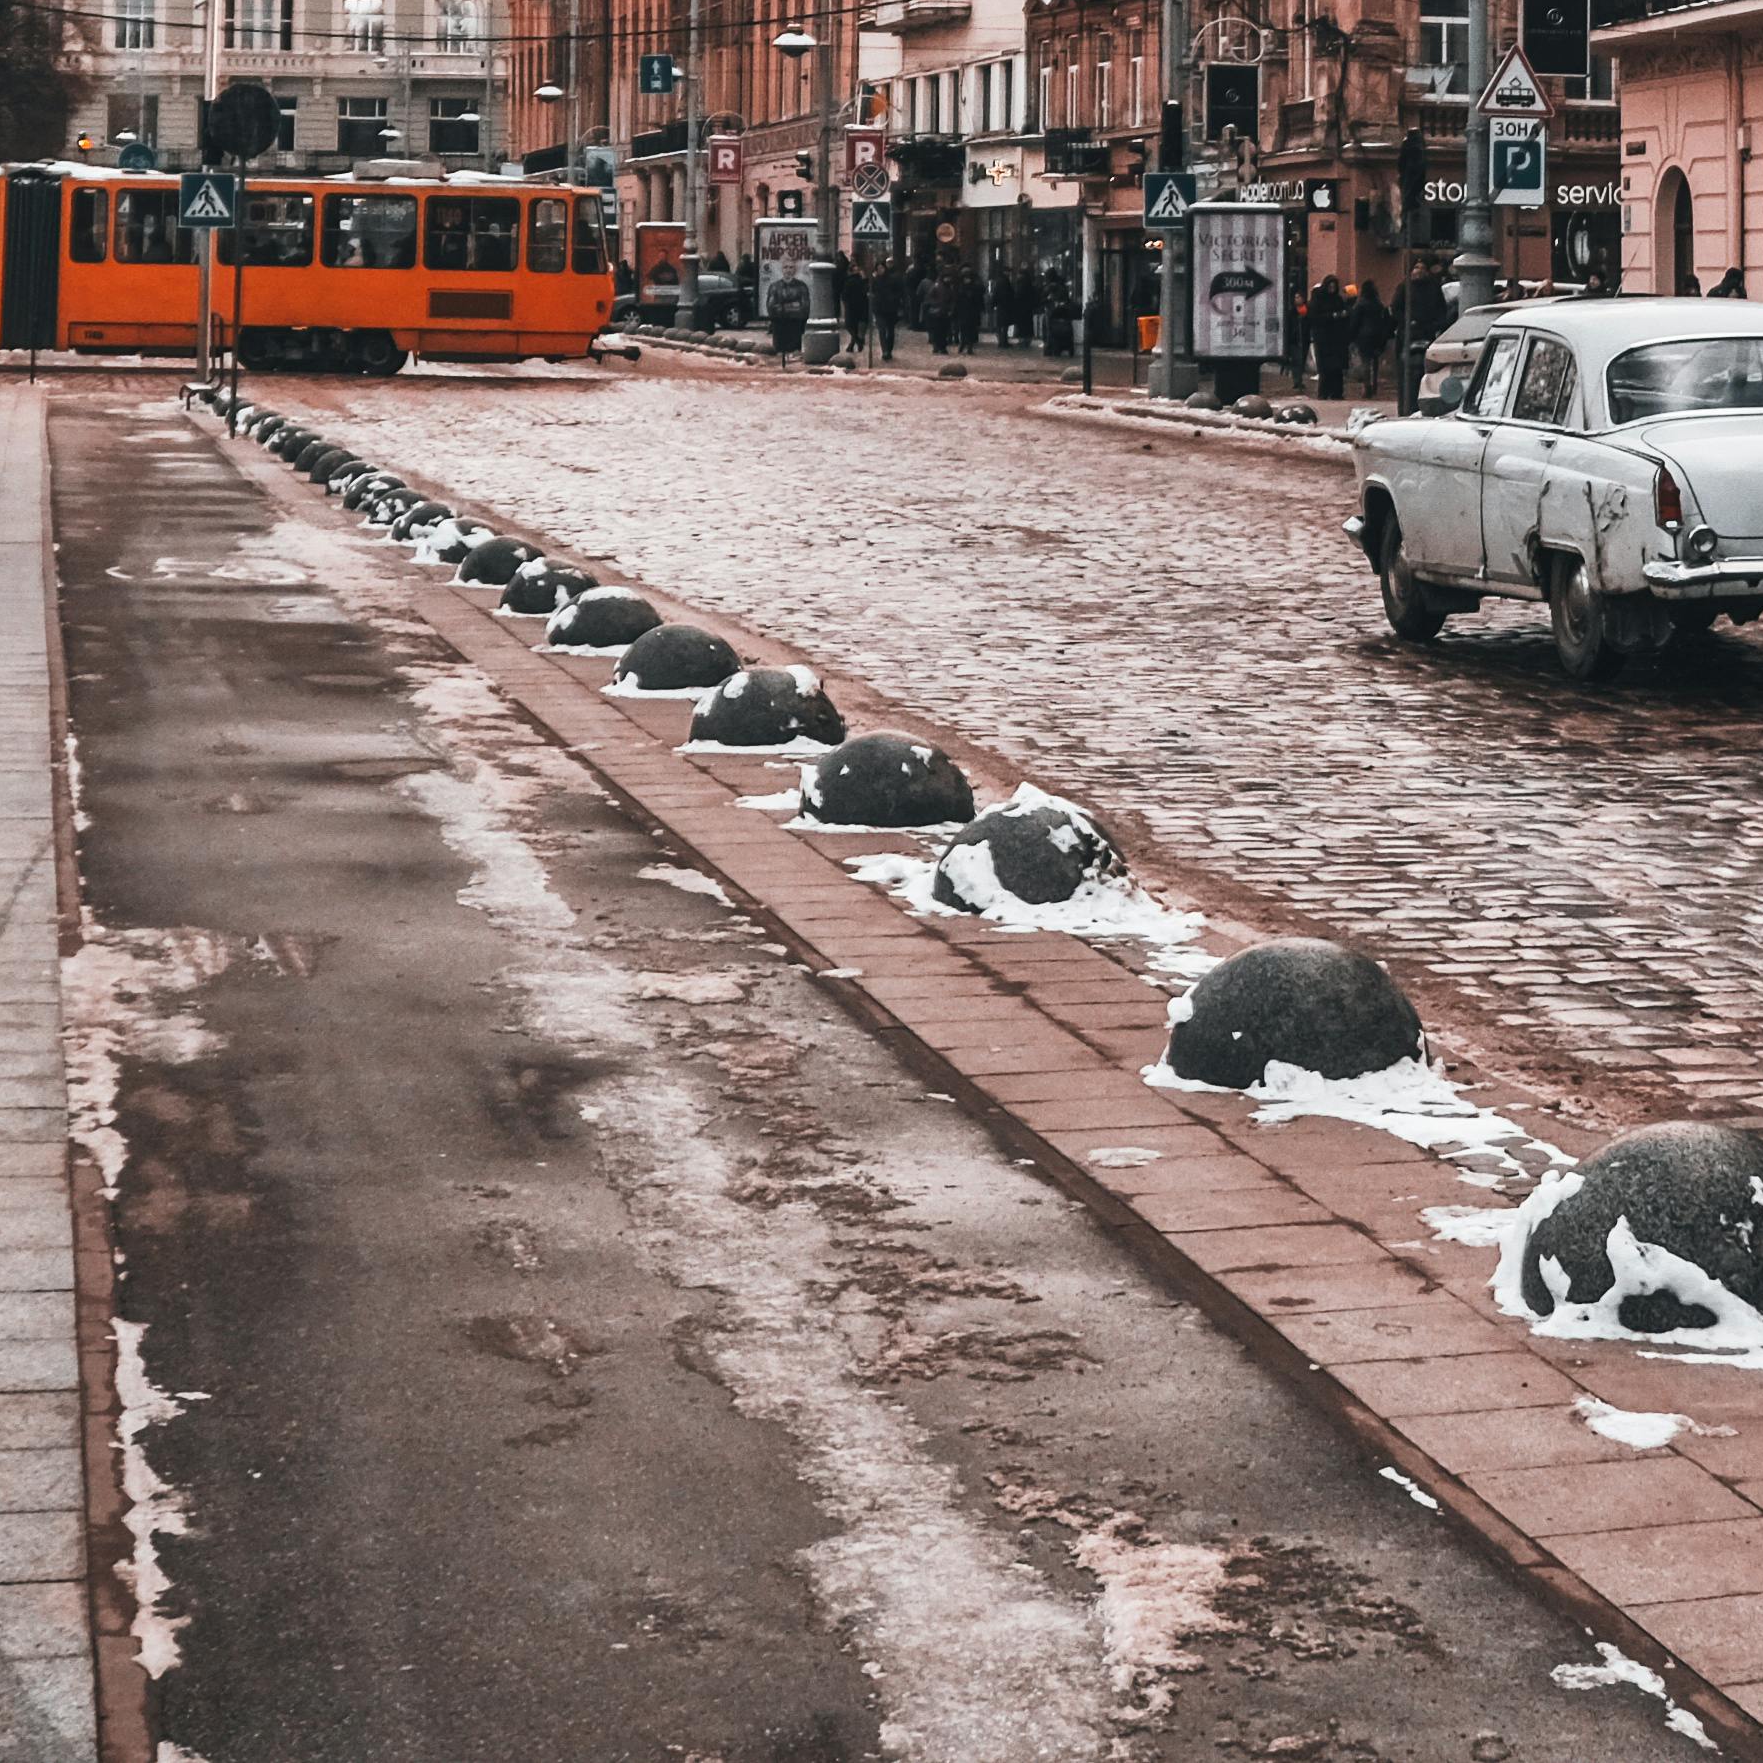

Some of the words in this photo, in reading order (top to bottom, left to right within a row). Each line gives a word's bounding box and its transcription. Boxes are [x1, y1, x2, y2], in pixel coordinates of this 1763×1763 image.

[1494, 122, 1540, 137] ЗОНА
[717, 148, 736, 170] R
[1506, 146, 1531, 184] P
